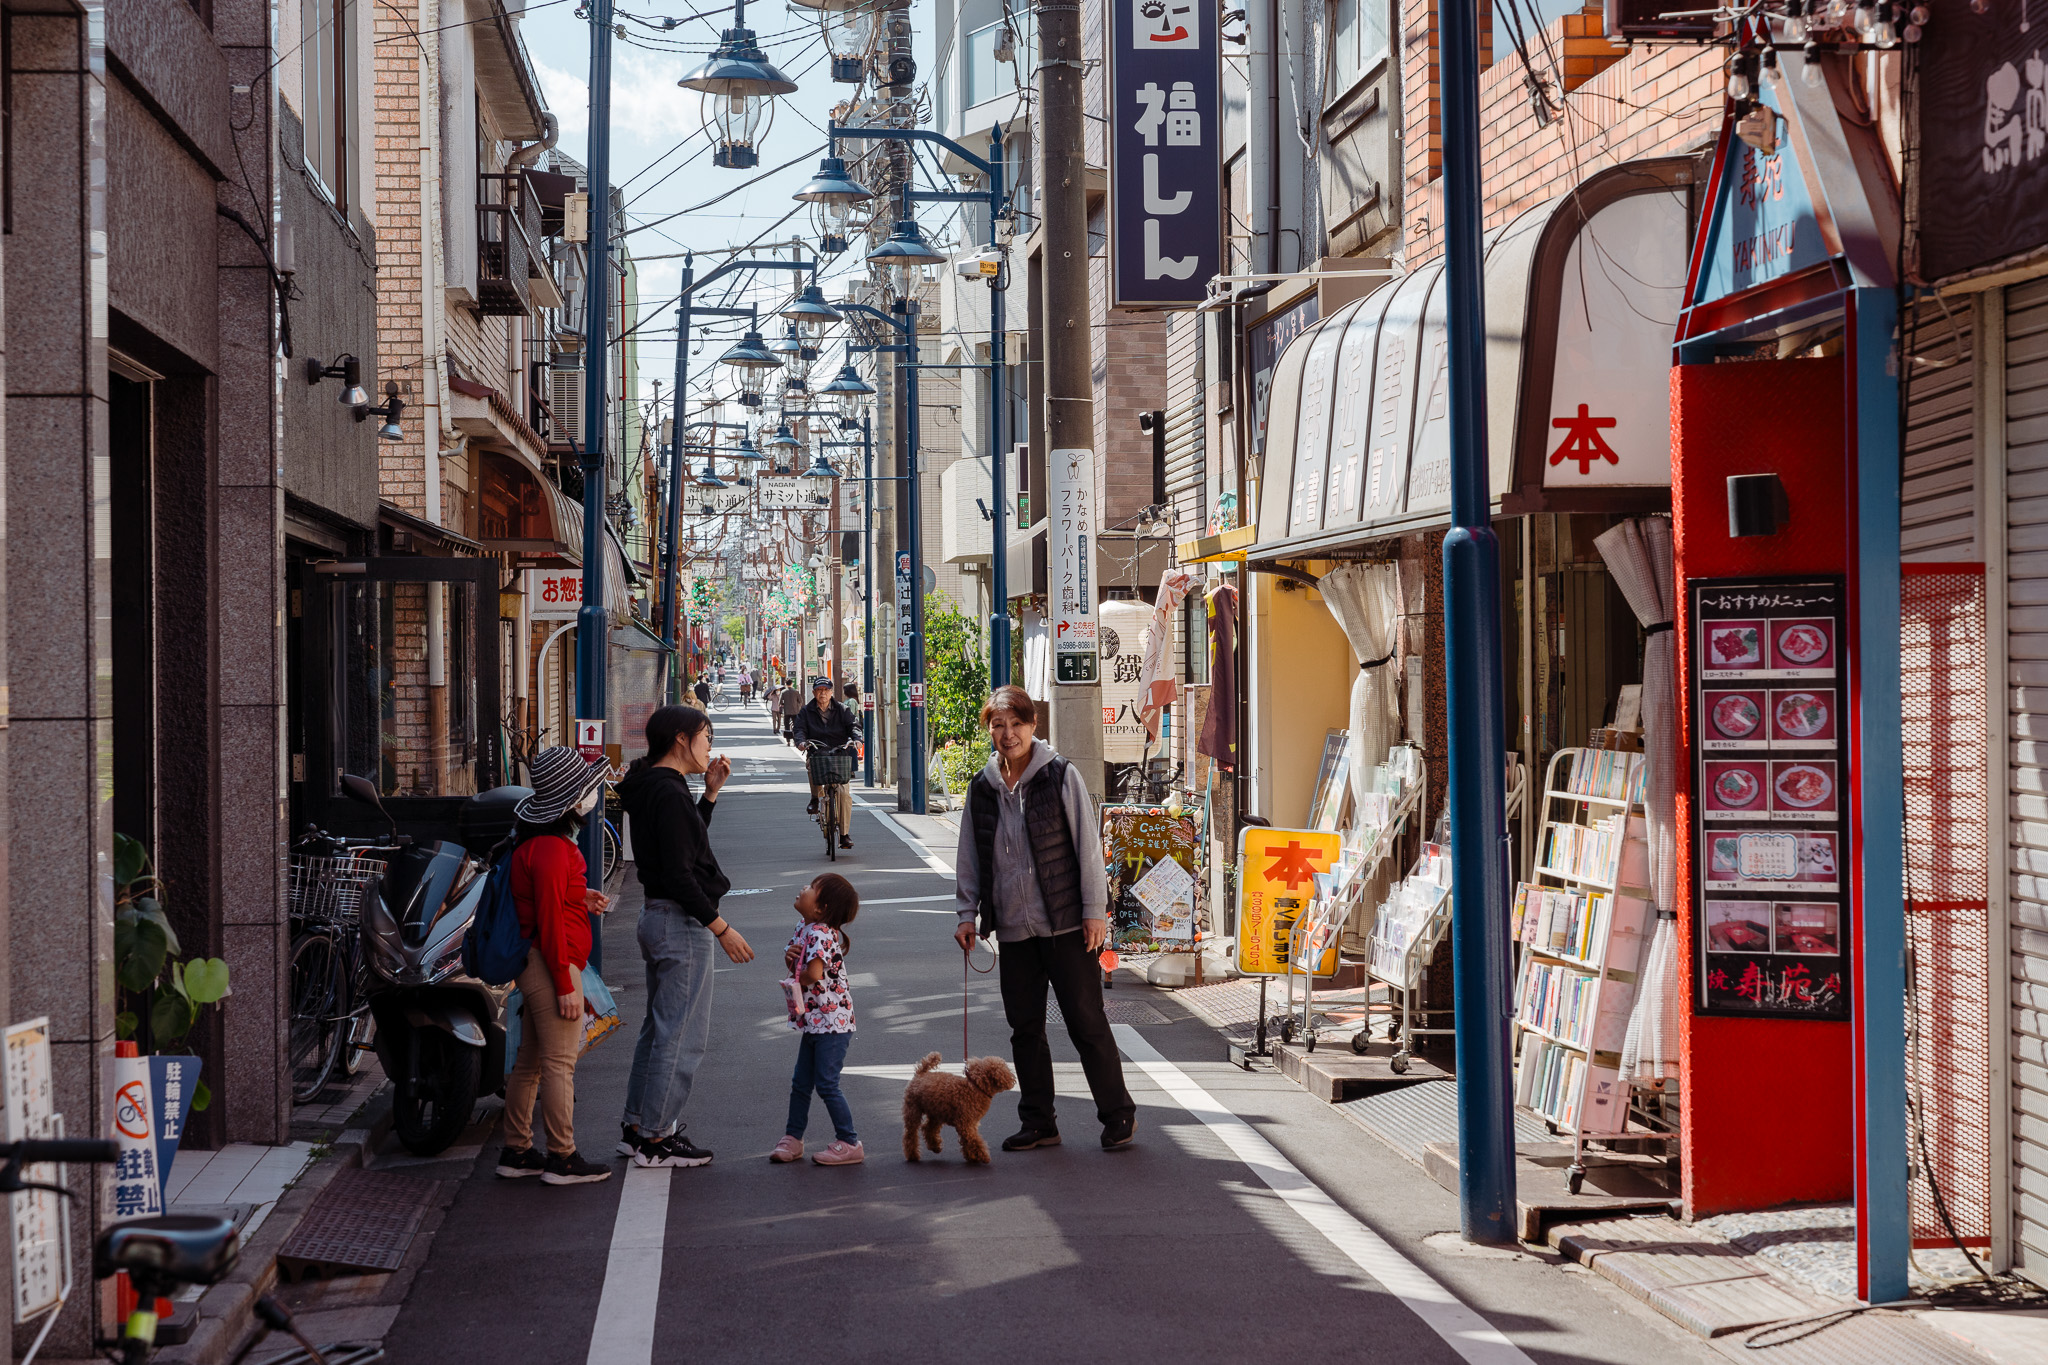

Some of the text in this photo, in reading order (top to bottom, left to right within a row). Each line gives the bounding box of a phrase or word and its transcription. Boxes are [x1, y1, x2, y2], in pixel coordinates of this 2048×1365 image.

[1133, 81, 1201, 281] 福しん
[1732, 220, 1795, 273] YAKINIKU
[1550, 403, 1620, 475] 本
[685, 494, 747, 508] サト通り
[763, 489, 817, 503] サミット通
[1076, 488, 1088, 531] かなめ
[1061, 490, 1074, 614] フラワーパーク歯科
[542, 576, 583, 603] お惣
[1065, 658, 1091, 668] 長崎
[1069, 669, 1088, 678] 1-5
[1140, 822, 1166, 833] Cafe
[1262, 841, 1323, 890] 本
[1119, 910, 1138, 919] OPEN
[163, 1061, 183, 1140] 駐輪禁止
